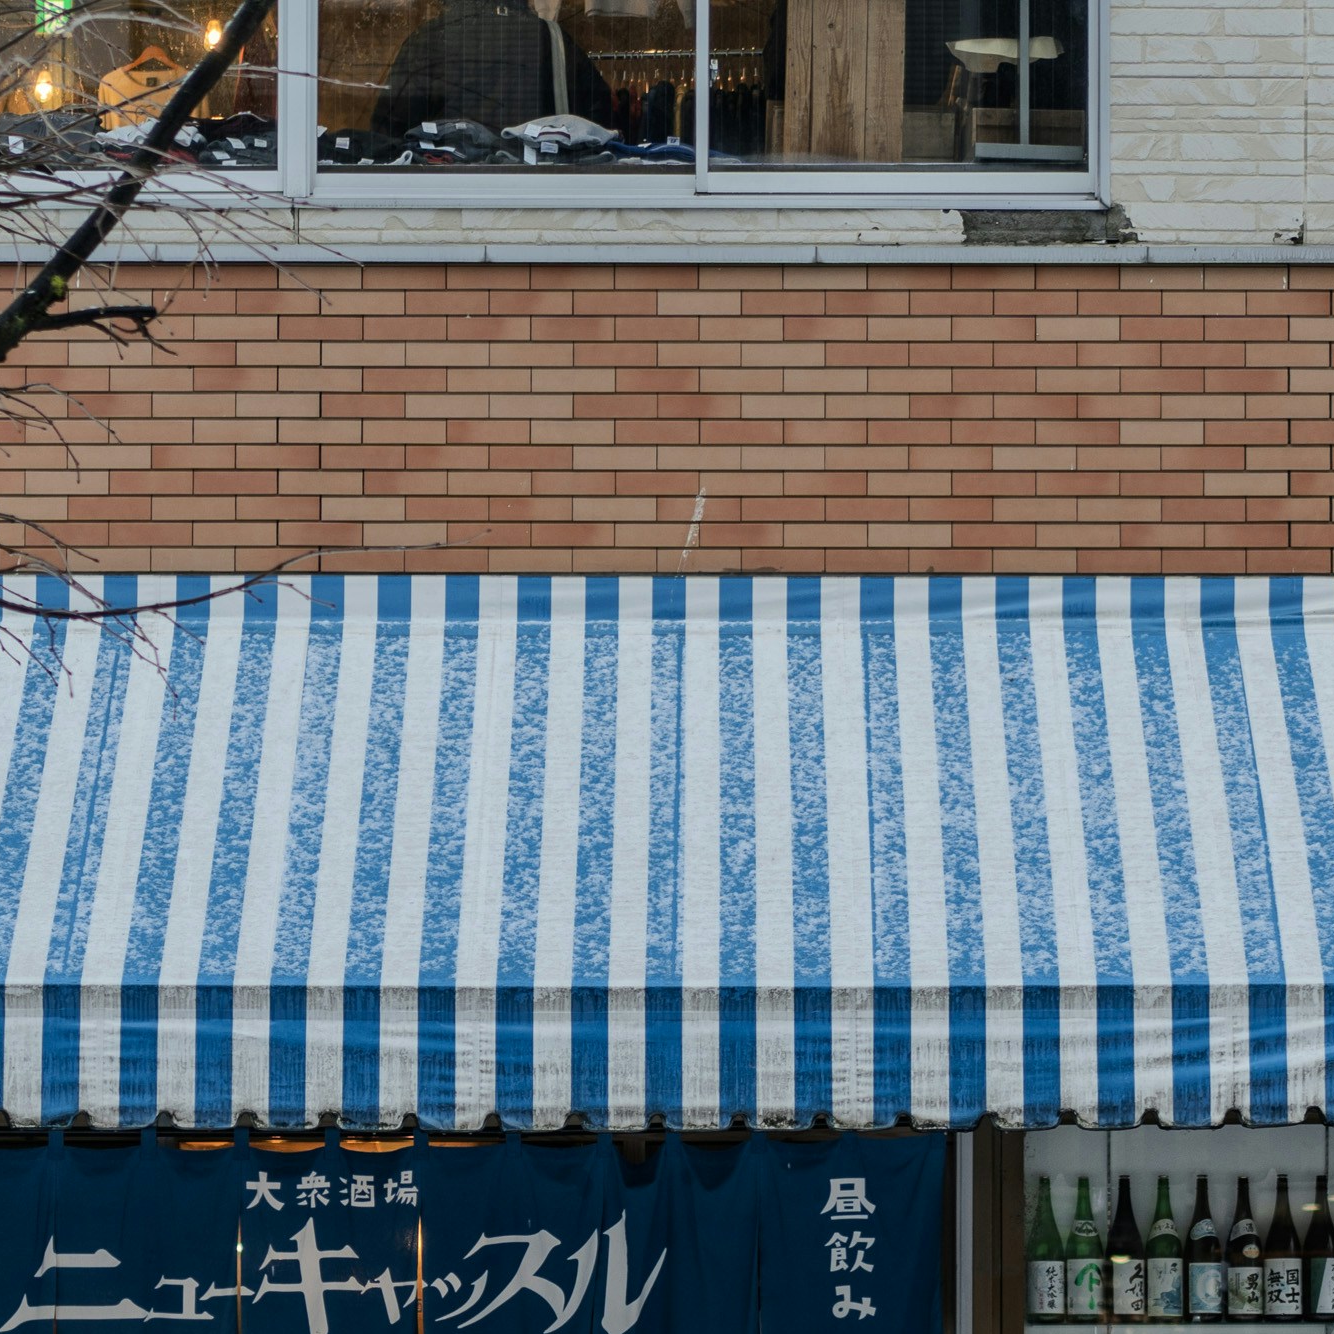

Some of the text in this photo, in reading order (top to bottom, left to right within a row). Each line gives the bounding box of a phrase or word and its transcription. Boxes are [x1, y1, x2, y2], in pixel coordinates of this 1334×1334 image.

[246, 1170, 418, 1209] 大衆酒場
[820, 1177, 877, 1320] 昼飲み
[1245, 1273, 1259, 1304] 男山
[1267, 1268, 1285, 1304] 無双
[1285, 1268, 1300, 1304] 国士
